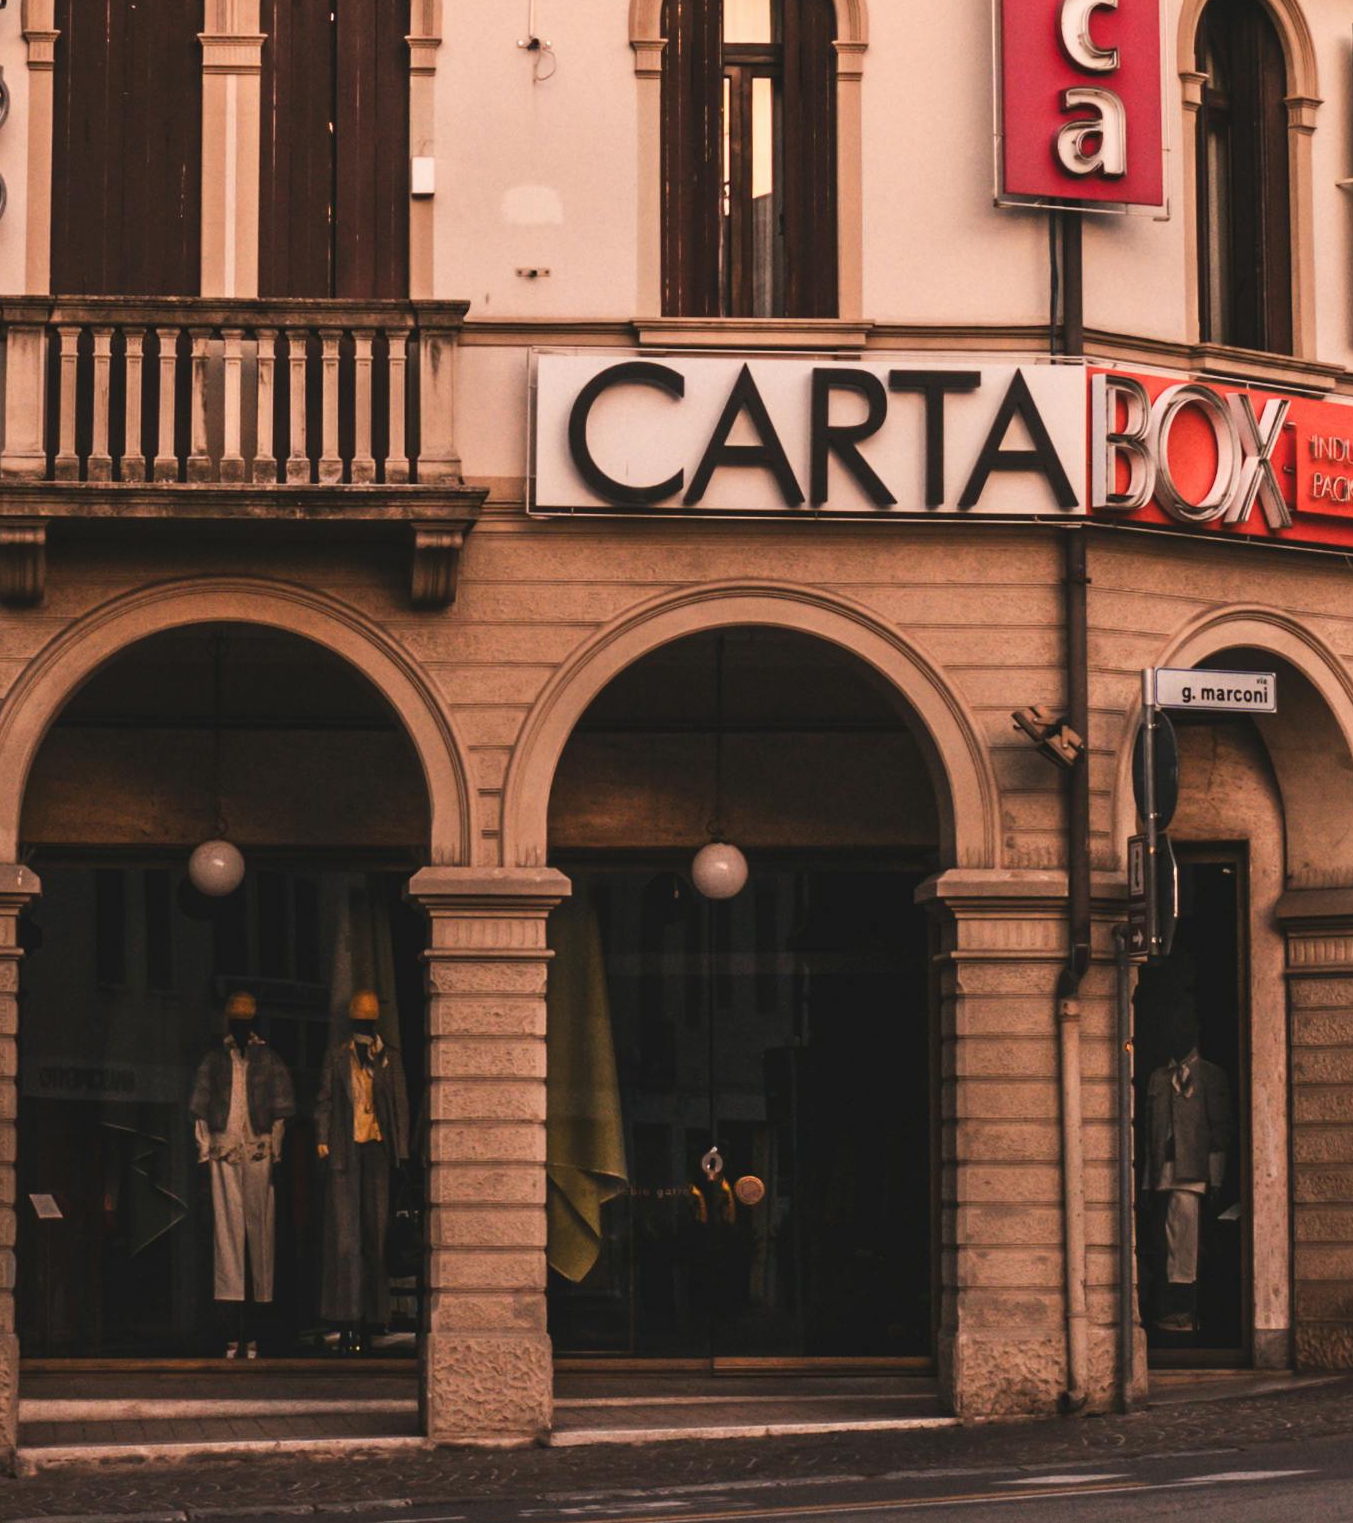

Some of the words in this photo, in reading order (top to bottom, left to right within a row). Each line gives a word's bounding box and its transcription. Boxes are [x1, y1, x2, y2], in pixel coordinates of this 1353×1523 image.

[567, 360, 1080, 510] CARTA
[1092, 372, 1294, 531] BOX
[1256, 677, 1268, 685] via
[1181, 686, 1196, 703] g.
[1201, 686, 1268, 704] marconi
